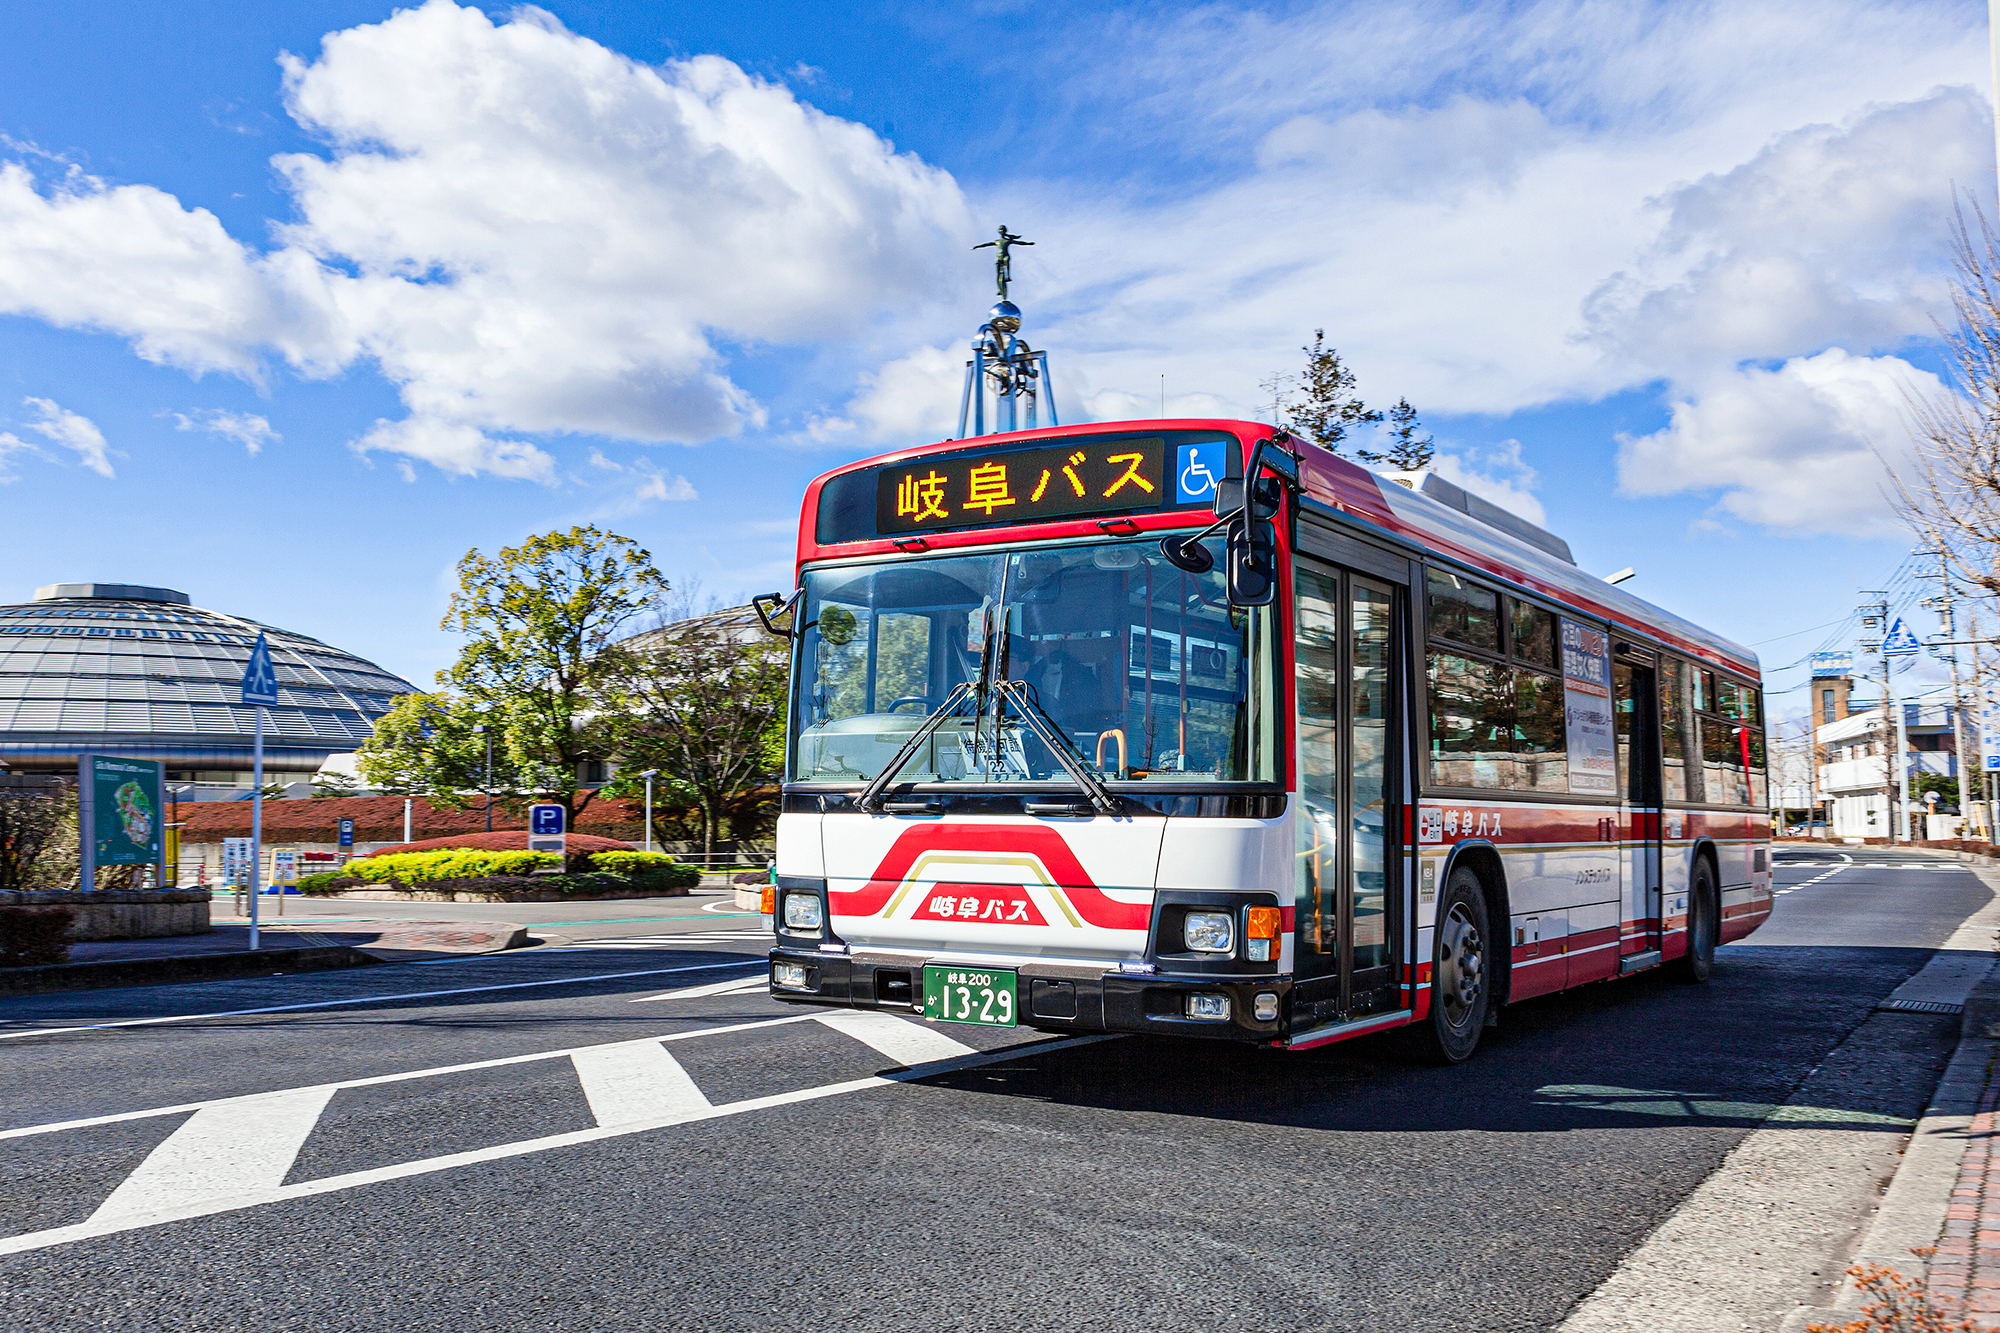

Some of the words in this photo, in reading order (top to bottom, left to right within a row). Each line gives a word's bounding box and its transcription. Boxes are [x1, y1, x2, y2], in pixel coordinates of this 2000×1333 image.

[897, 451, 1155, 522] 岐阜バス
[990, 761, 1006, 773] 22
[540, 810, 556, 825] P
[1444, 809, 1502, 837] 岐阜バス
[1430, 830, 1440, 839] EXIT
[928, 895, 1030, 922] 岐阜バス
[927, 994, 938, 1007] か
[943, 985, 1012, 1023] 13-29
